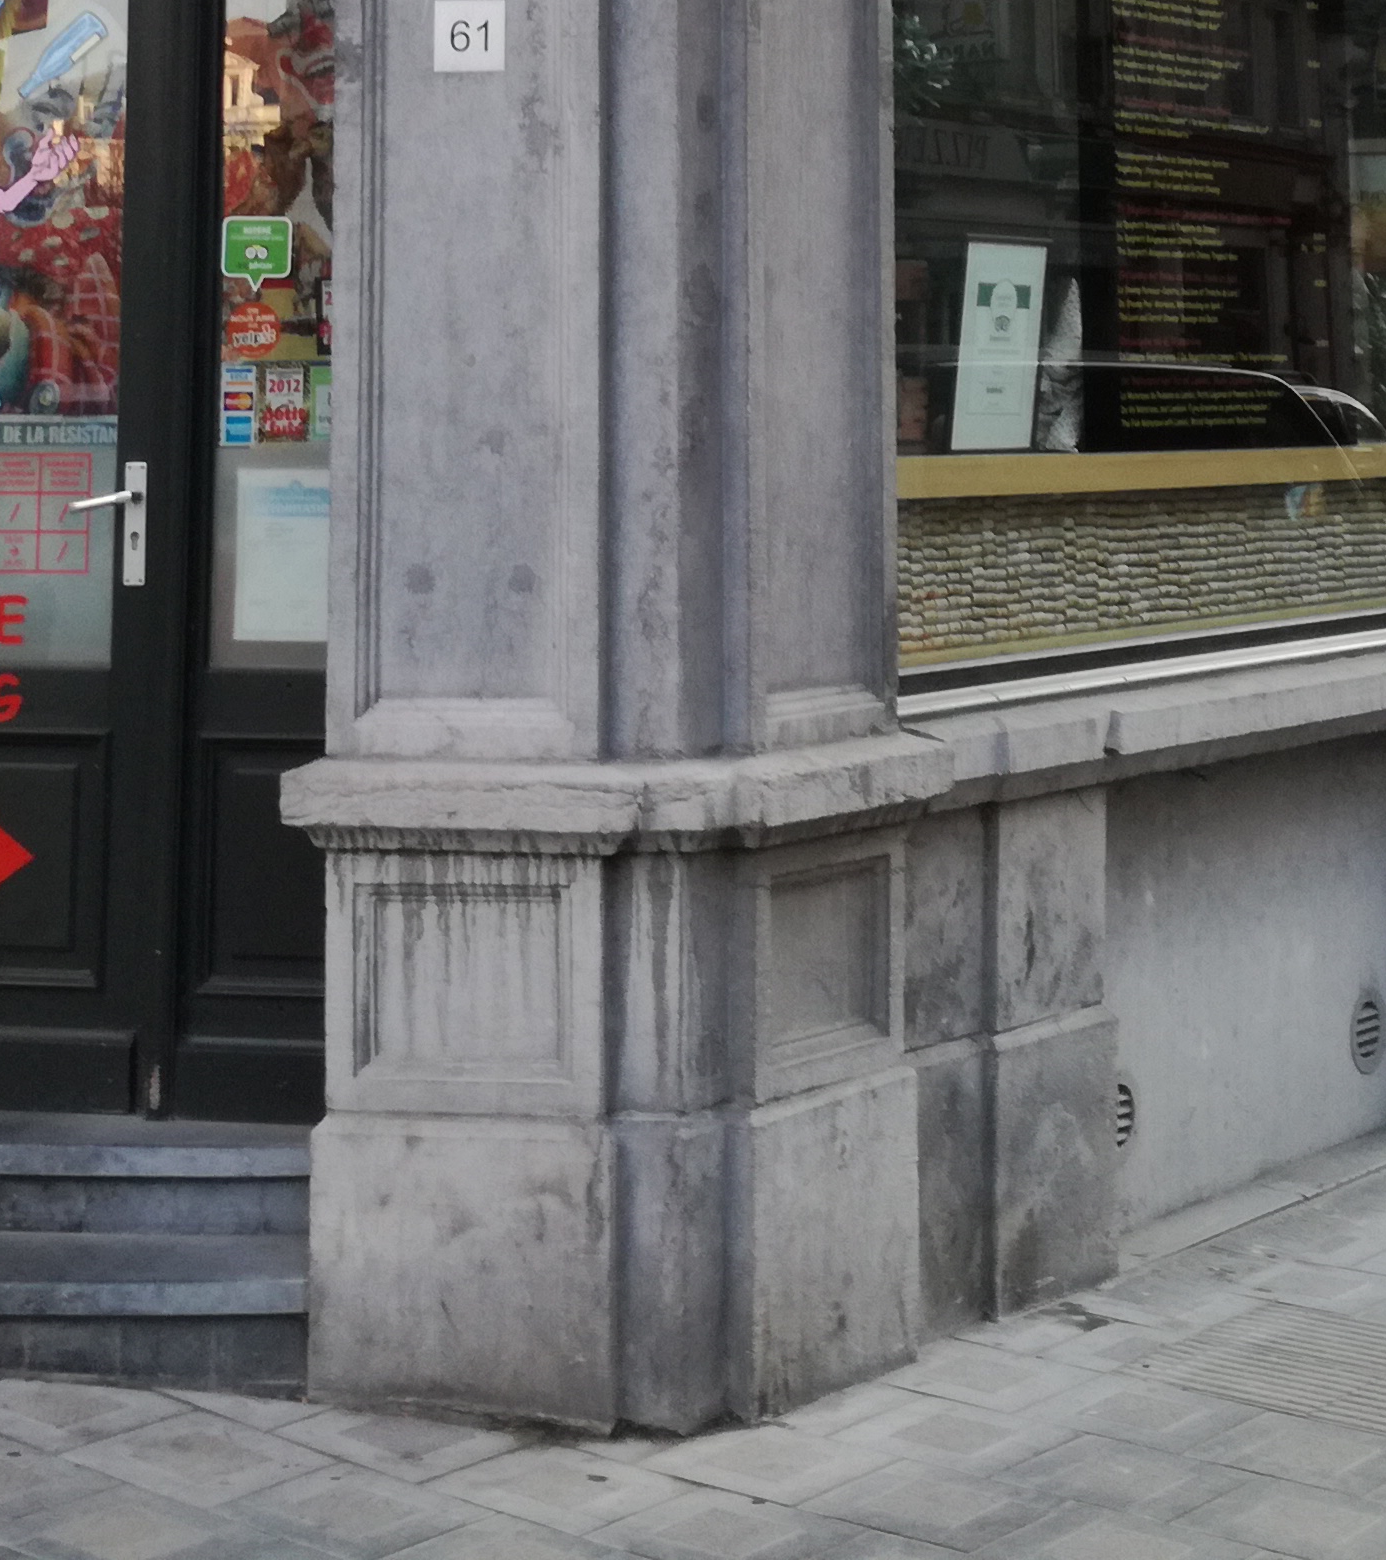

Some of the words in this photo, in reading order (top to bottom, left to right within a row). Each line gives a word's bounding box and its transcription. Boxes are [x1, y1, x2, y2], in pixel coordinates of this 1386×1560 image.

[449, 18, 490, 54] 61
[268, 378, 302, 393] 2012
[4, 424, 22, 445] DE
[26, 424, 46, 445] LA
